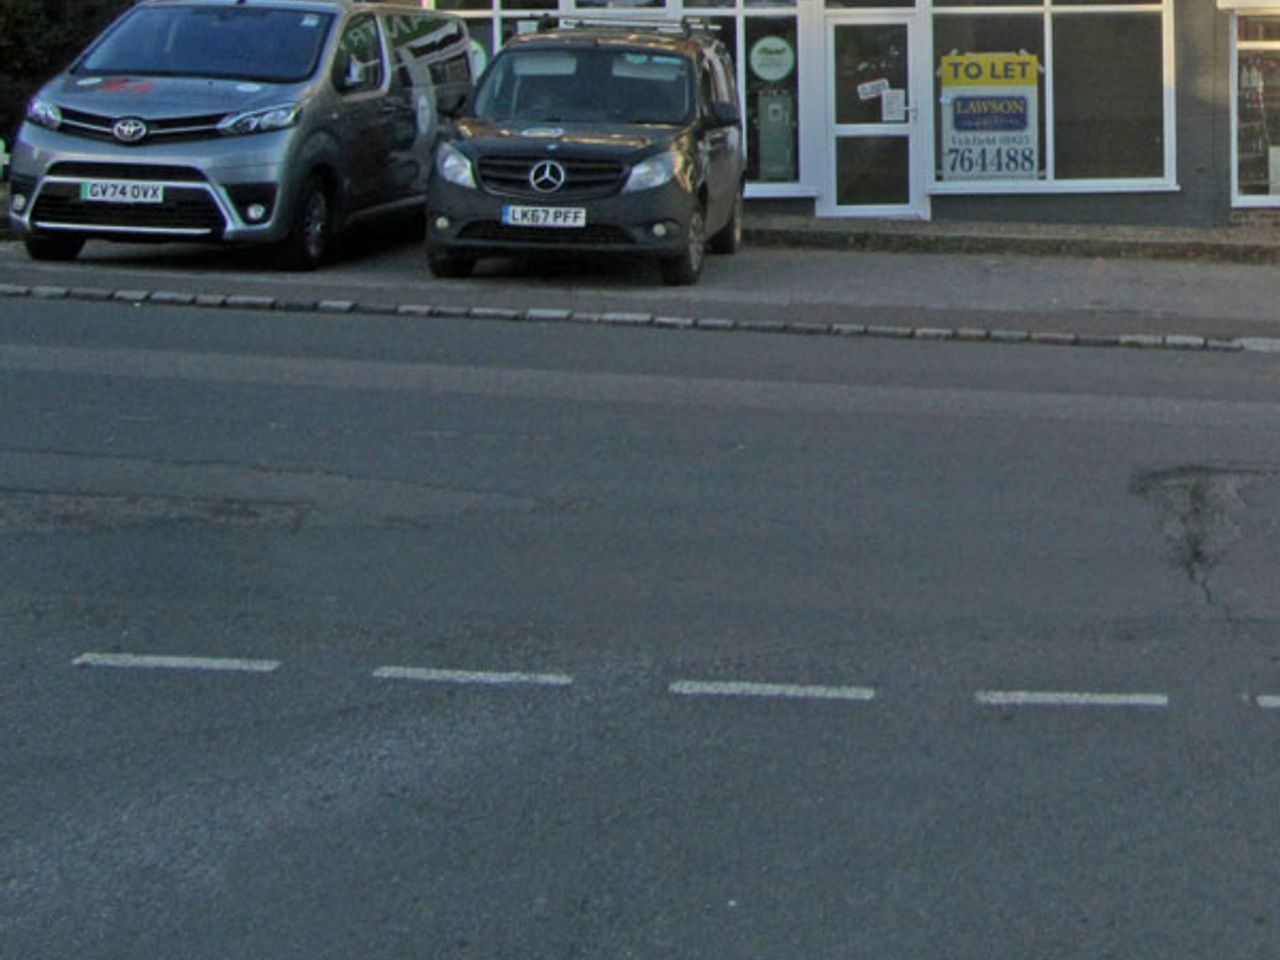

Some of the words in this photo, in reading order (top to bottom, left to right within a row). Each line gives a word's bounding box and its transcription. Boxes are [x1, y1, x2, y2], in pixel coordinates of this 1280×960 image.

[948, 62, 983, 80] TO
[990, 62, 1031, 79] LET
[956, 101, 1025, 114] LAWSON
[947, 147, 1035, 173] 764488
[89, 183, 127, 198] GV74
[131, 185, 160, 199] OVX
[511, 208, 549, 224] LK67
[553, 208, 583, 224] PFF
